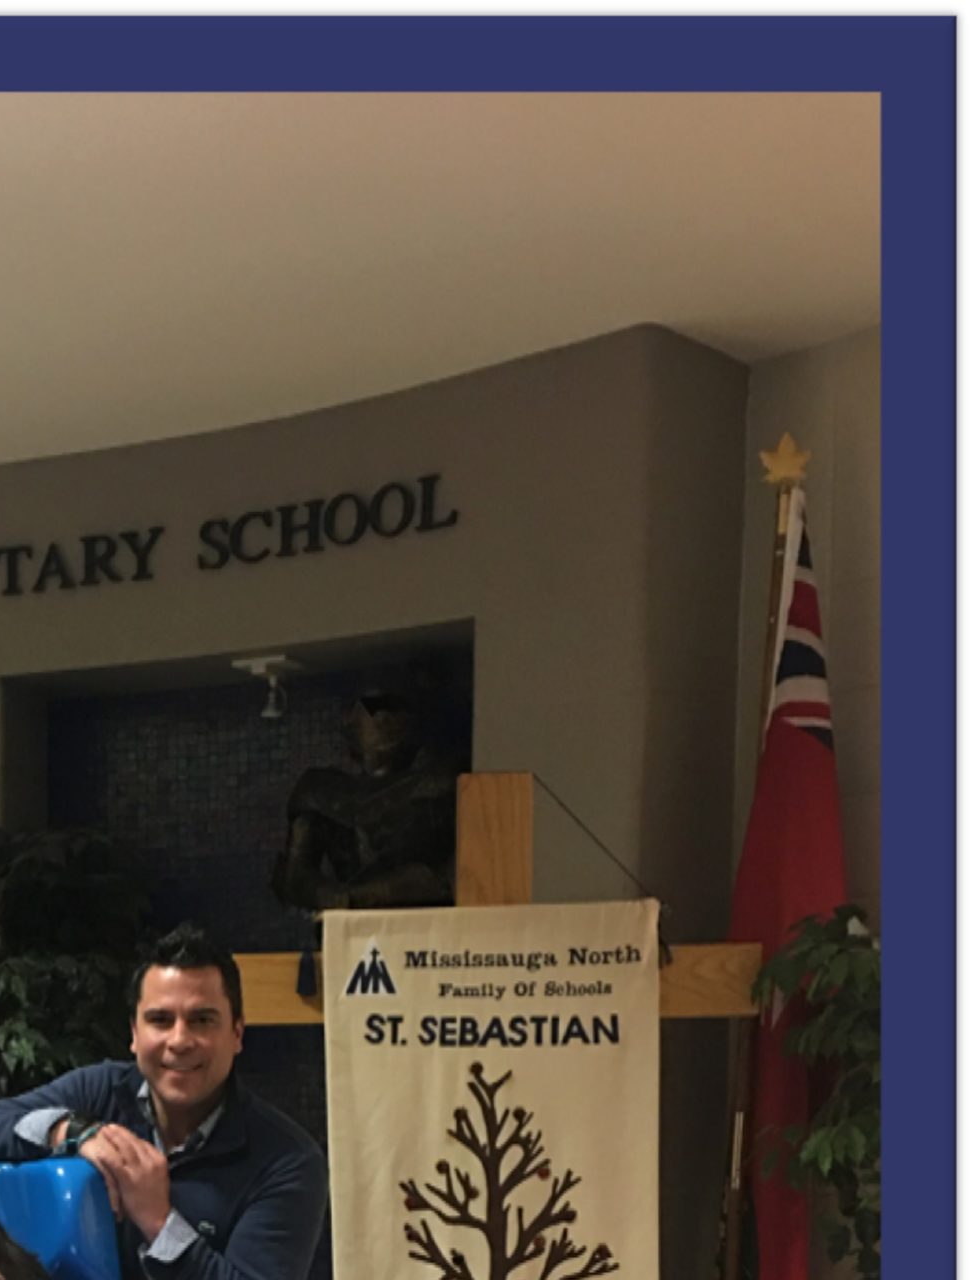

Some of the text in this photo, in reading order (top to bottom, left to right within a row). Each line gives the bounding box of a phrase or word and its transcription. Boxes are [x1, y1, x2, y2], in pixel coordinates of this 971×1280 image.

[195, 473, 459, 572] SCHOOL
[404, 945, 642, 971] Mississauga North
[438, 981, 613, 1000] Family Of Schools
[364, 1013, 620, 1047] ST. SEBASTIAN
